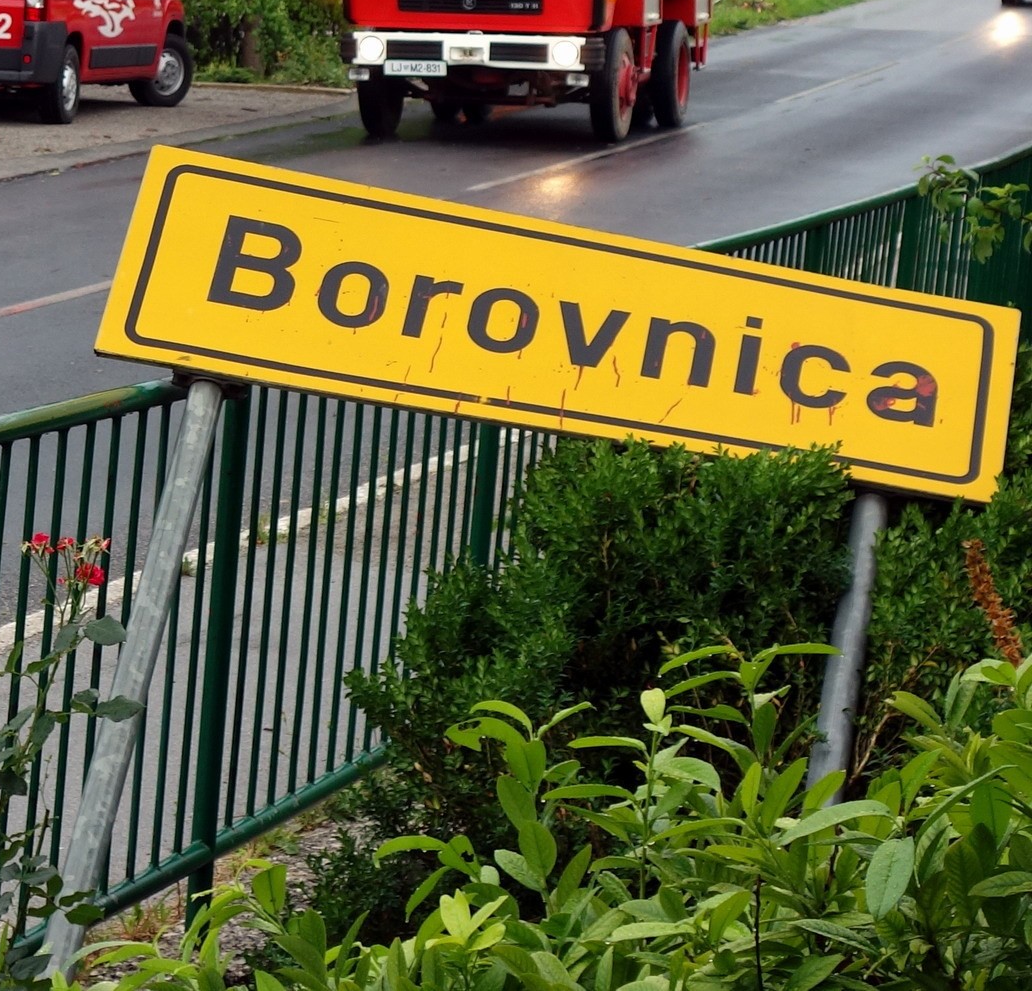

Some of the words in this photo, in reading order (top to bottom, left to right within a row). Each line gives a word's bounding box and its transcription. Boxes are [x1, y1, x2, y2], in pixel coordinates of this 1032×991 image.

[391, 62, 403, 73] LJ
[410, 63, 441, 73] M2-831
[207, 214, 939, 428] Borovnica
